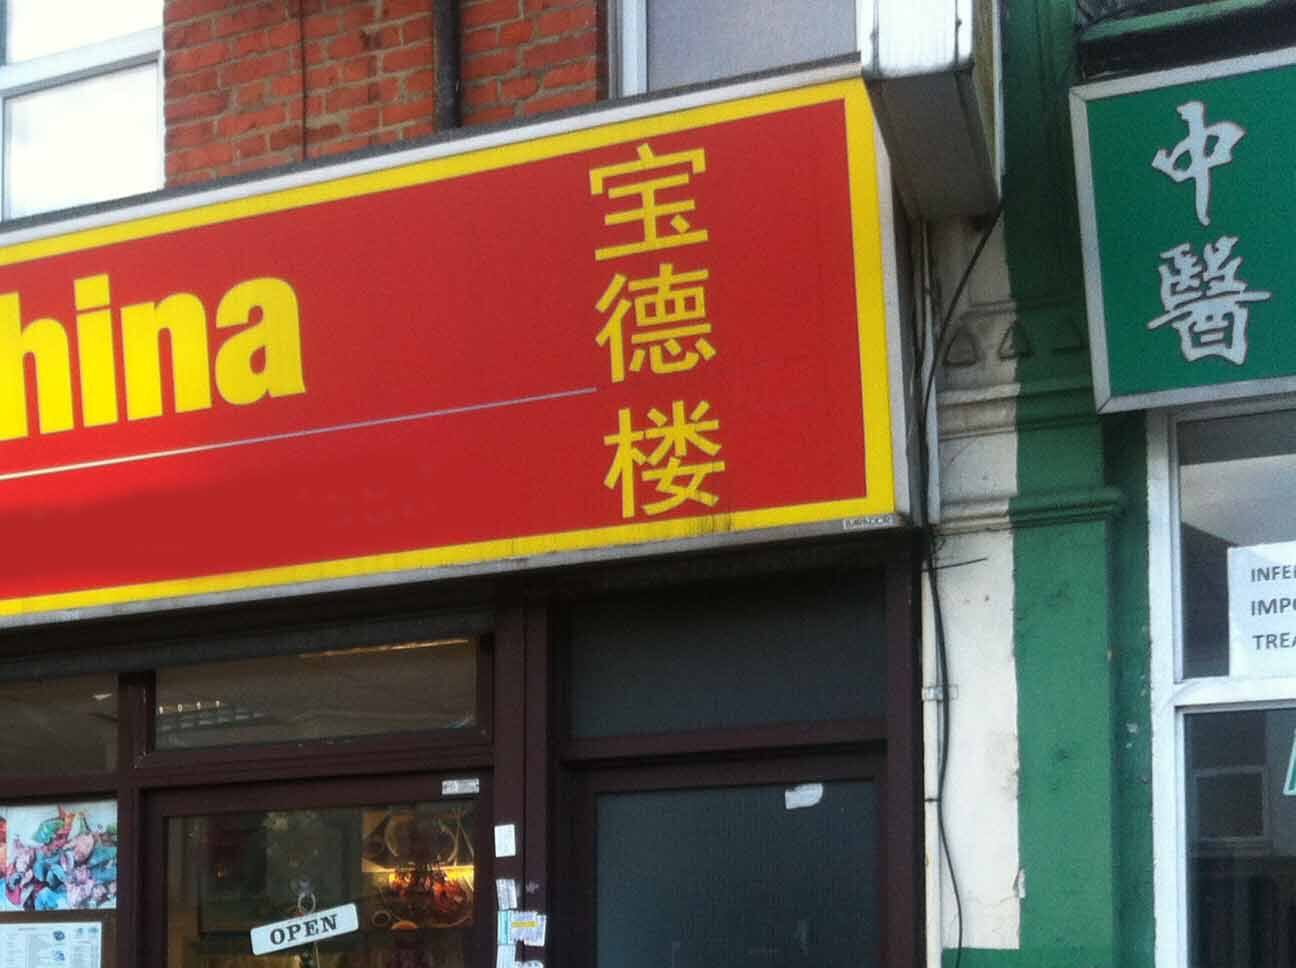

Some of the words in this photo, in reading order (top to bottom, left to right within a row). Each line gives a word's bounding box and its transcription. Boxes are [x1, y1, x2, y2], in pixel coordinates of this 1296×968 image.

[590, 142, 728, 519] 宝德楼
[1146, 100, 1272, 366] 中醫
[270, 914, 338, 945] OPEN
